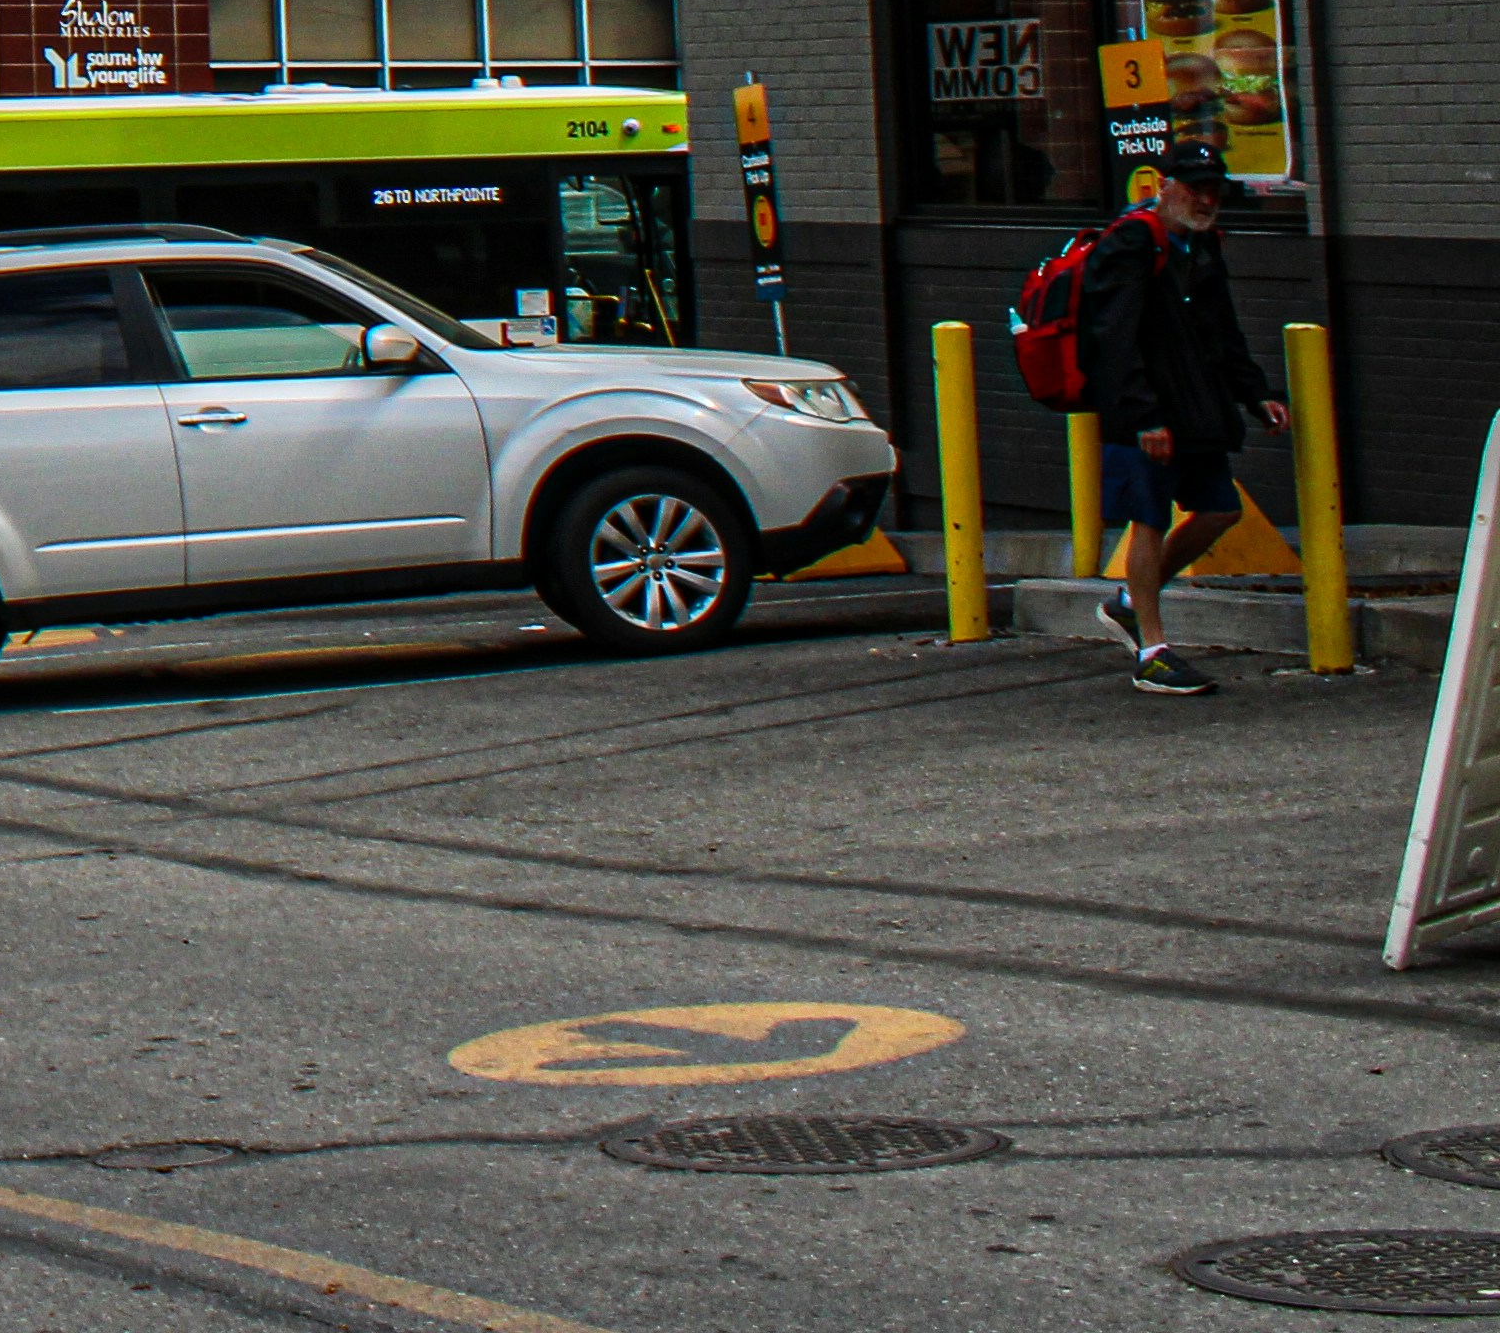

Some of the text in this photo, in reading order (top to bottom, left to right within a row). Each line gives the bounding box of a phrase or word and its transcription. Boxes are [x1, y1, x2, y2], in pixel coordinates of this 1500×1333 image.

[60, 26, 151, 38] MINISTRIES
[86, 66, 167, 89] younglife
[1124, 60, 1141, 89] 3
[566, 120, 610, 138] 2104
[1110, 117, 1168, 137] Curbside
[1117, 136, 1166, 156] Pick Up
[373, 187, 501, 204] 26 TO NORTHPOINTE
